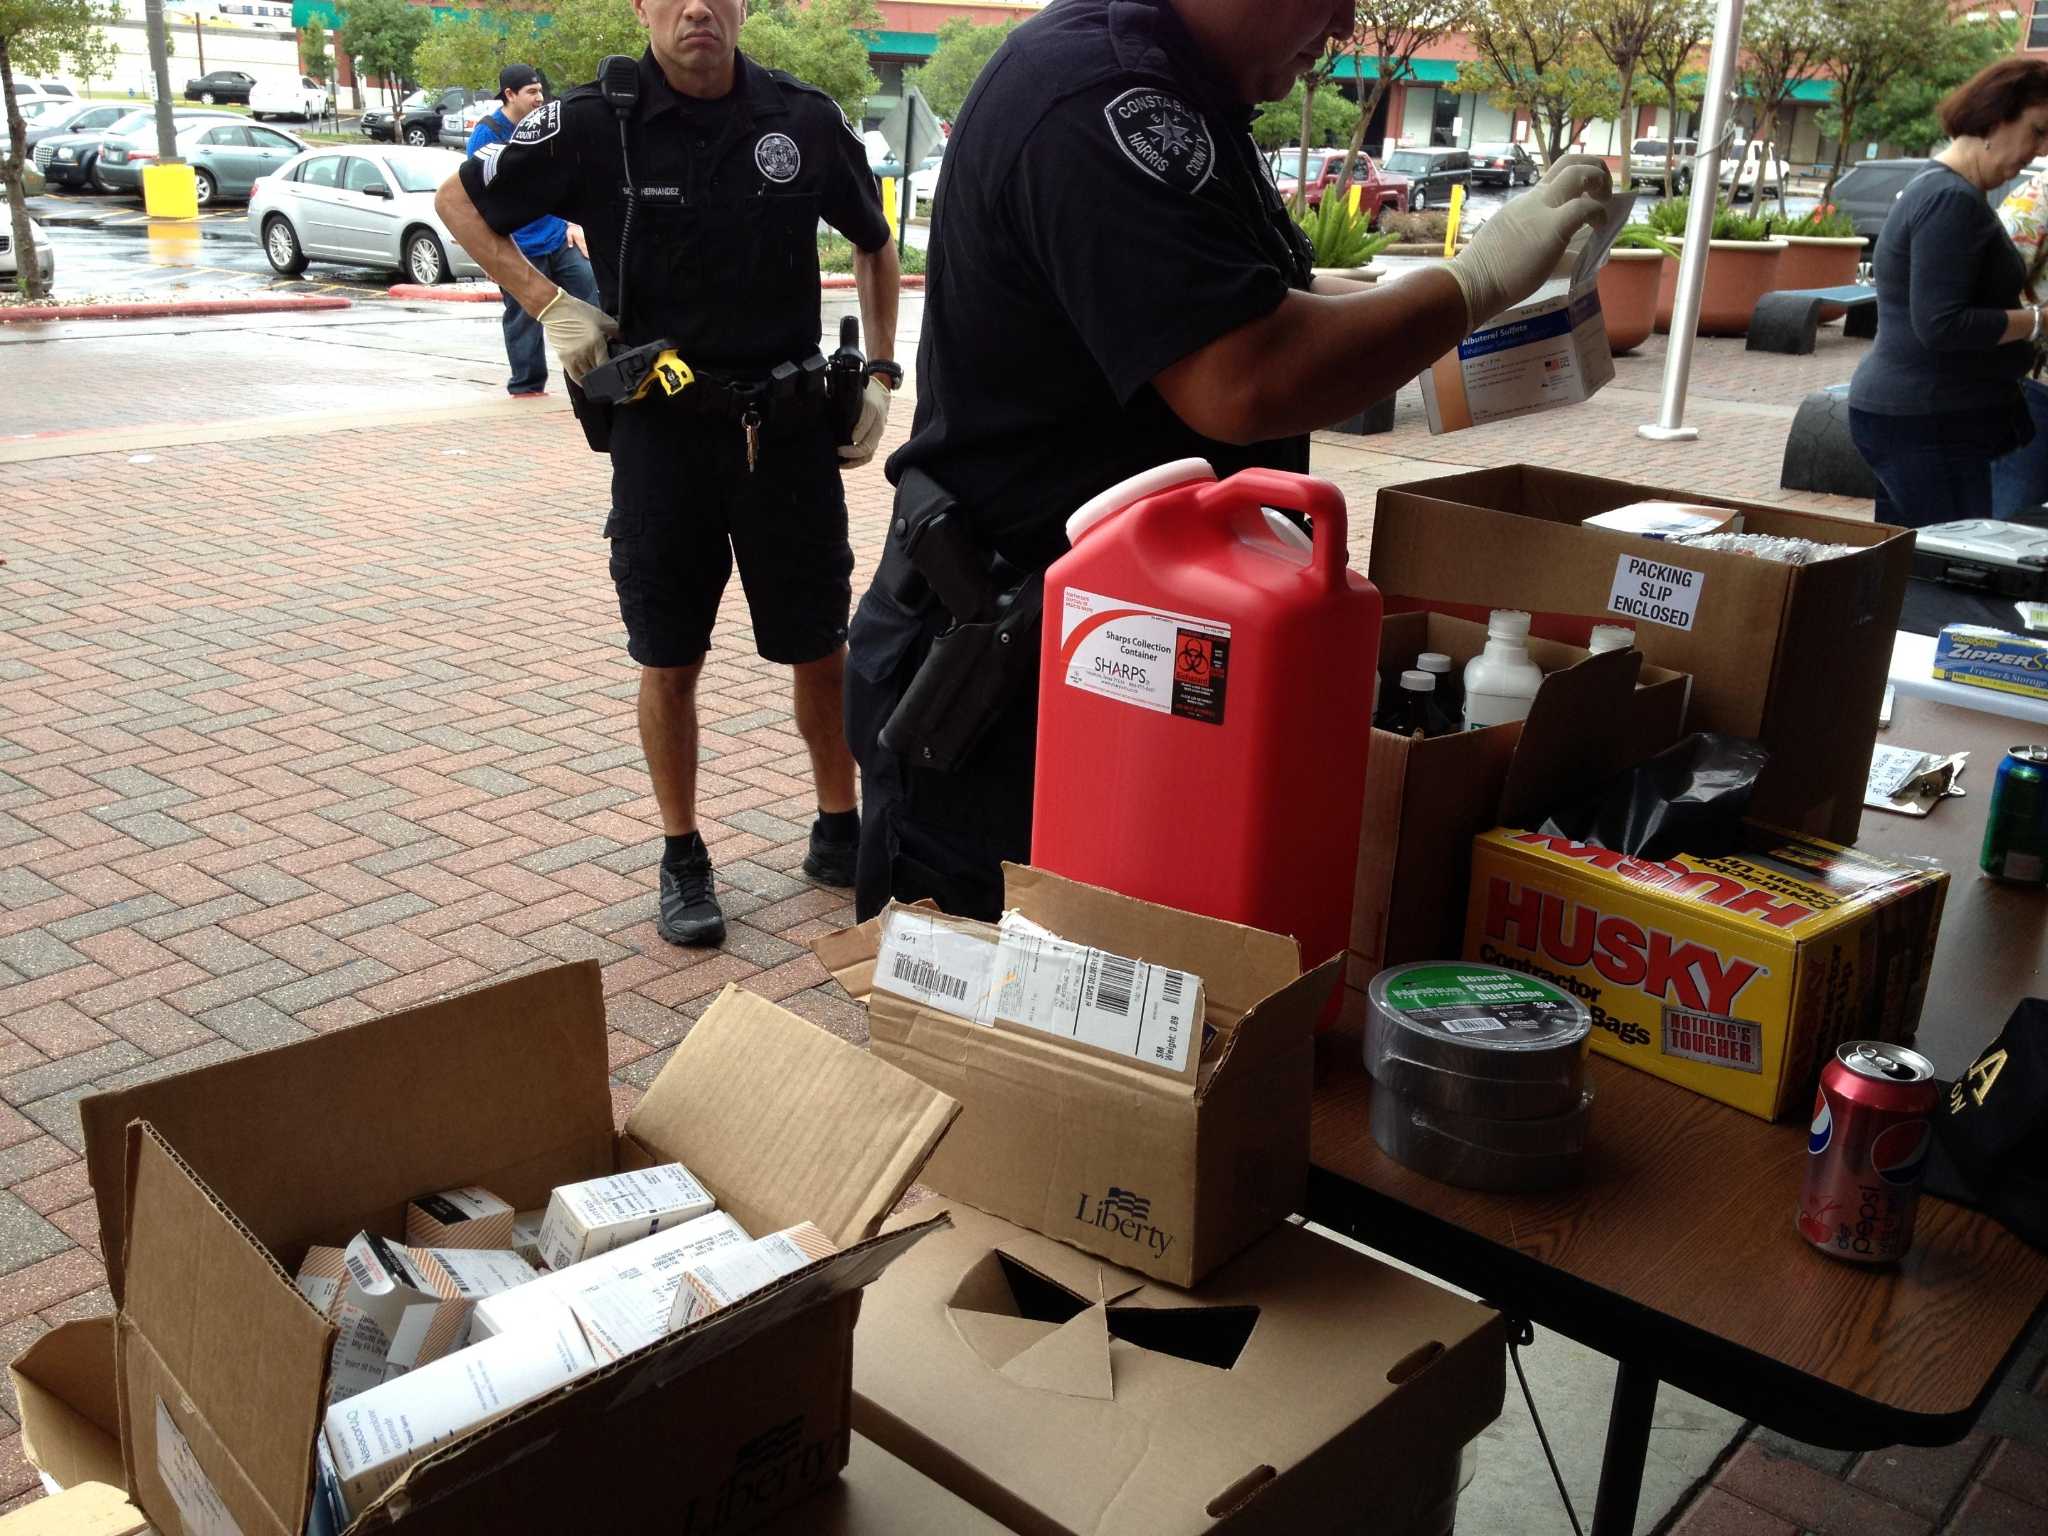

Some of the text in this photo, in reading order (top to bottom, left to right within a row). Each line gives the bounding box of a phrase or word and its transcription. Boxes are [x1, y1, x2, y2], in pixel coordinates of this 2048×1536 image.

[515, 129, 541, 140] COUNTY
[1127, 131, 1208, 177] HARRIS COUNTY
[640, 186, 680, 197] HERNANDEZ
[1628, 558, 1693, 588] PACKING
[1638, 581, 1673, 602] SLIP
[1613, 595, 1690, 627] ENCLOSED
[1106, 630, 1172, 655] Sharps Collection
[1120, 645, 1158, 662] Container
[1094, 656, 1146, 684] SHARPS
[1484, 876, 1761, 1017] HUSKY
[1456, 973, 1512, 983] General
[1465, 982, 1524, 992] Purpose
[1477, 991, 1510, 1000] Duct
[1512, 989, 1545, 999] Tape
[1590, 1004, 1651, 1045] Bags
[1670, 1013, 1752, 1042] NOTHING'S
[1074, 1192, 1174, 1259] Liberty
[1852, 1185, 1881, 1255] pepsi
